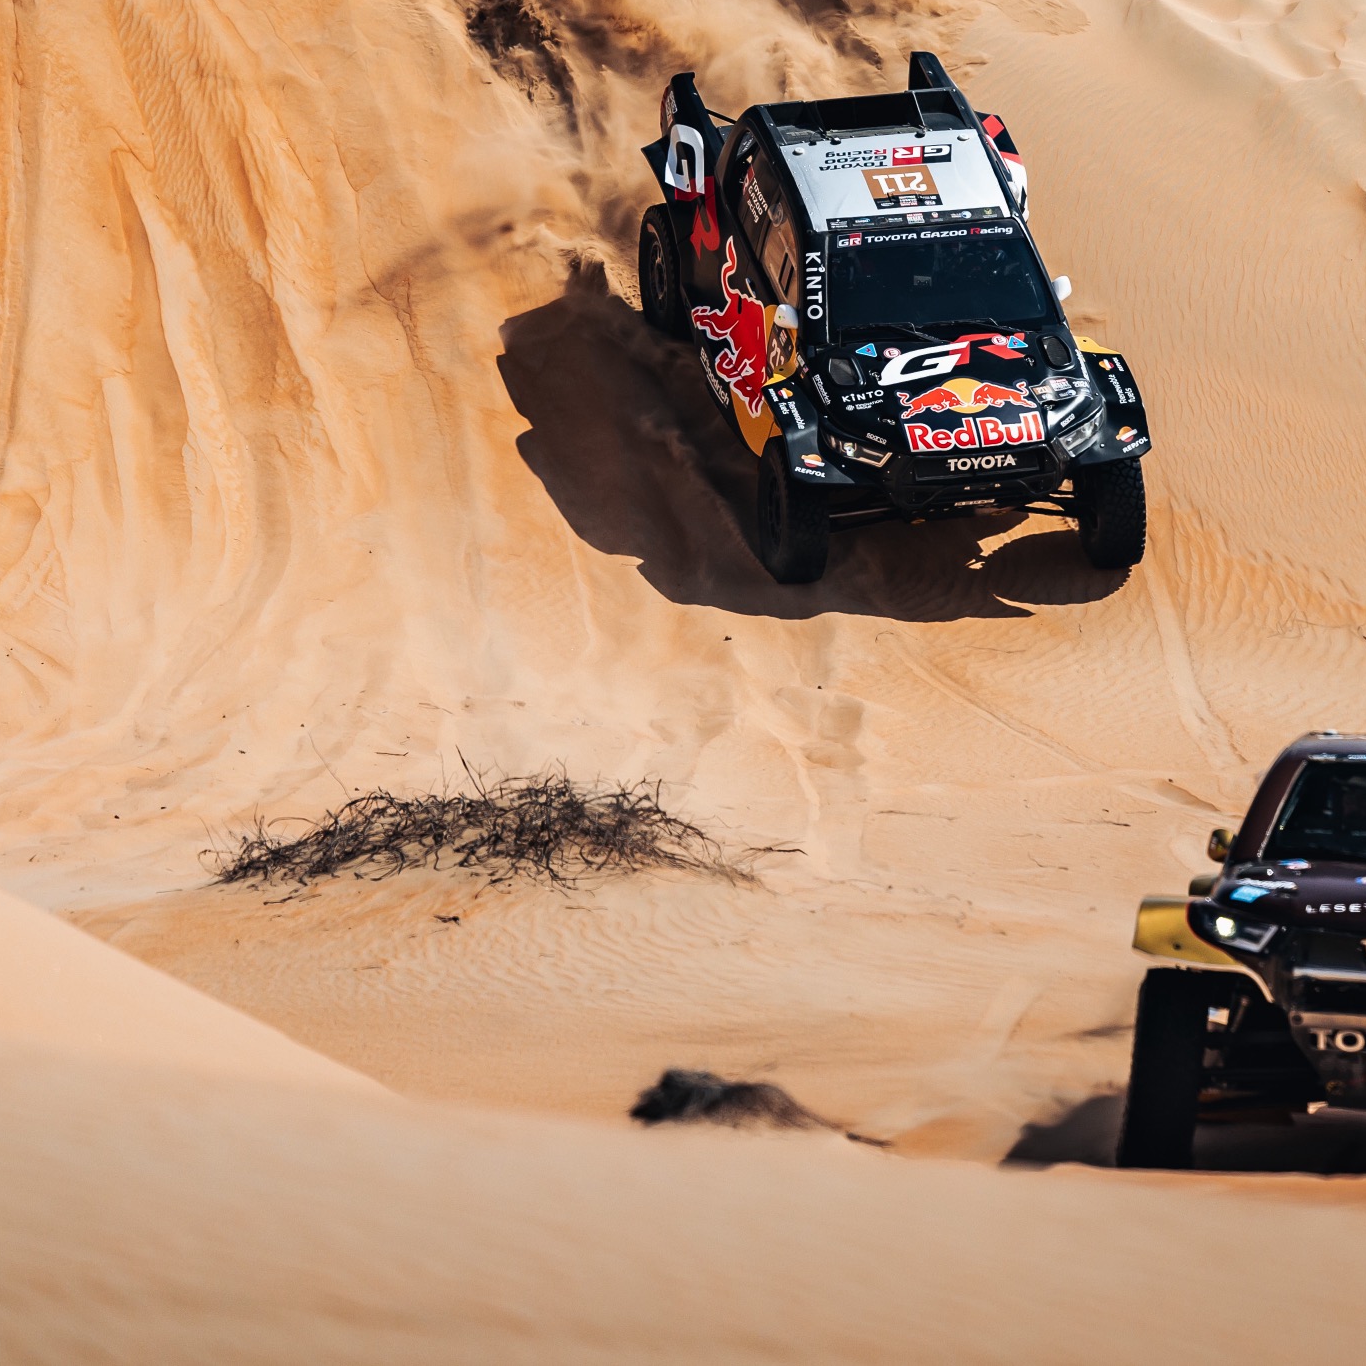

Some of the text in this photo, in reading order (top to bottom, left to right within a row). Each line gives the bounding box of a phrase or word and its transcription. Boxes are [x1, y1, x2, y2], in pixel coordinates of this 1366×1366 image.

[824, 155, 887, 165] GAZOO
[825, 148, 887, 158] Racing
[893, 145, 951, 159] GR
[819, 161, 888, 171] TOYOTA
[752, 177, 768, 211] TOYOTA
[872, 172, 927, 195] 211
[747, 195, 759, 223] acing
[748, 185, 763, 215] GAZOO
[838, 226, 1013, 247] GR TOYOTA GAZOO Racing
[878, 333, 1025, 386] GR
[1108, 374, 1127, 404] Renewable
[787, 401, 805, 430] Renewable
[906, 413, 1043, 451] Red Bull
[1122, 436, 1148, 453] REPSOL
[794, 466, 826, 478] REPSOL
[947, 454, 1016, 472] TOYOTA
